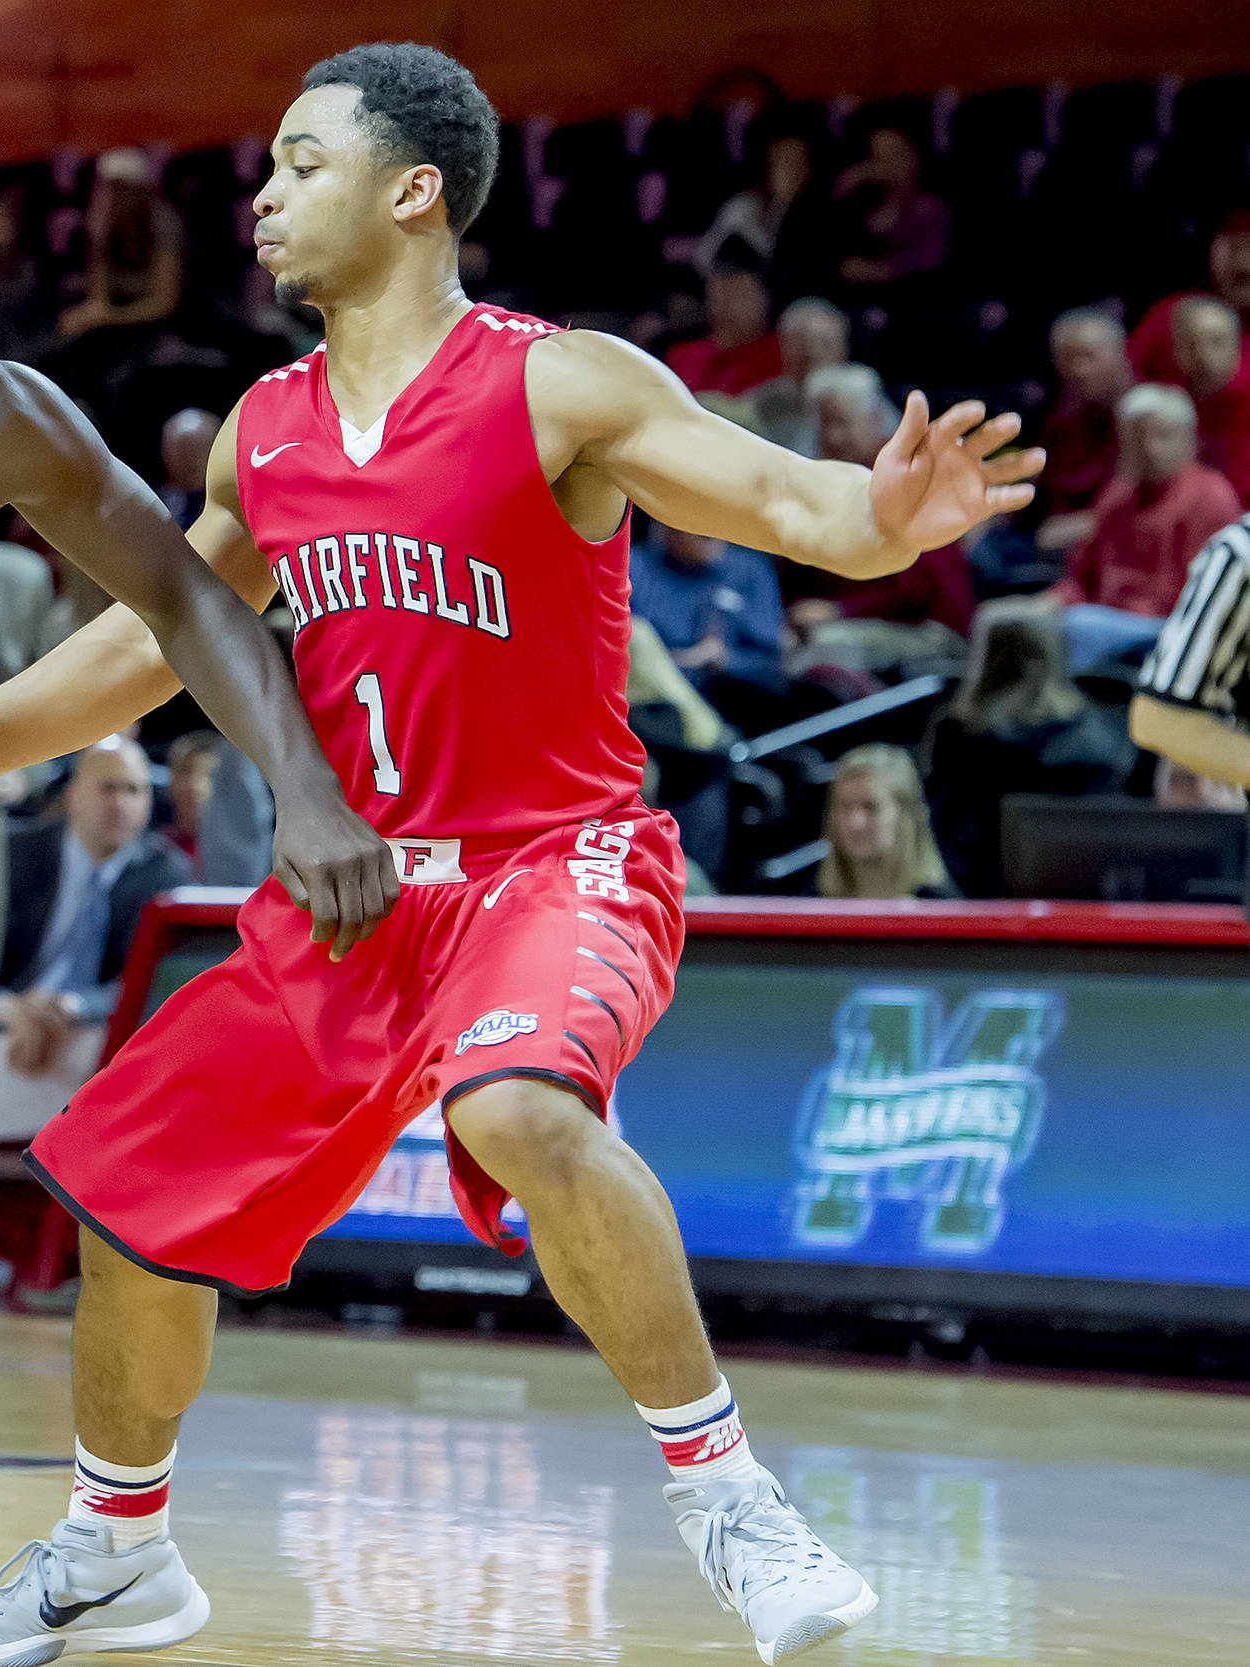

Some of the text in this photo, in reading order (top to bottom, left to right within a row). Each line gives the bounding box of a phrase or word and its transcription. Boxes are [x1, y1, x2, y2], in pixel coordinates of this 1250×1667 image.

[272, 532, 512, 640] AIRFIELD
[354, 672, 401, 797] 1
[399, 845, 432, 877] F
[455, 1011, 538, 1054] MAAC
